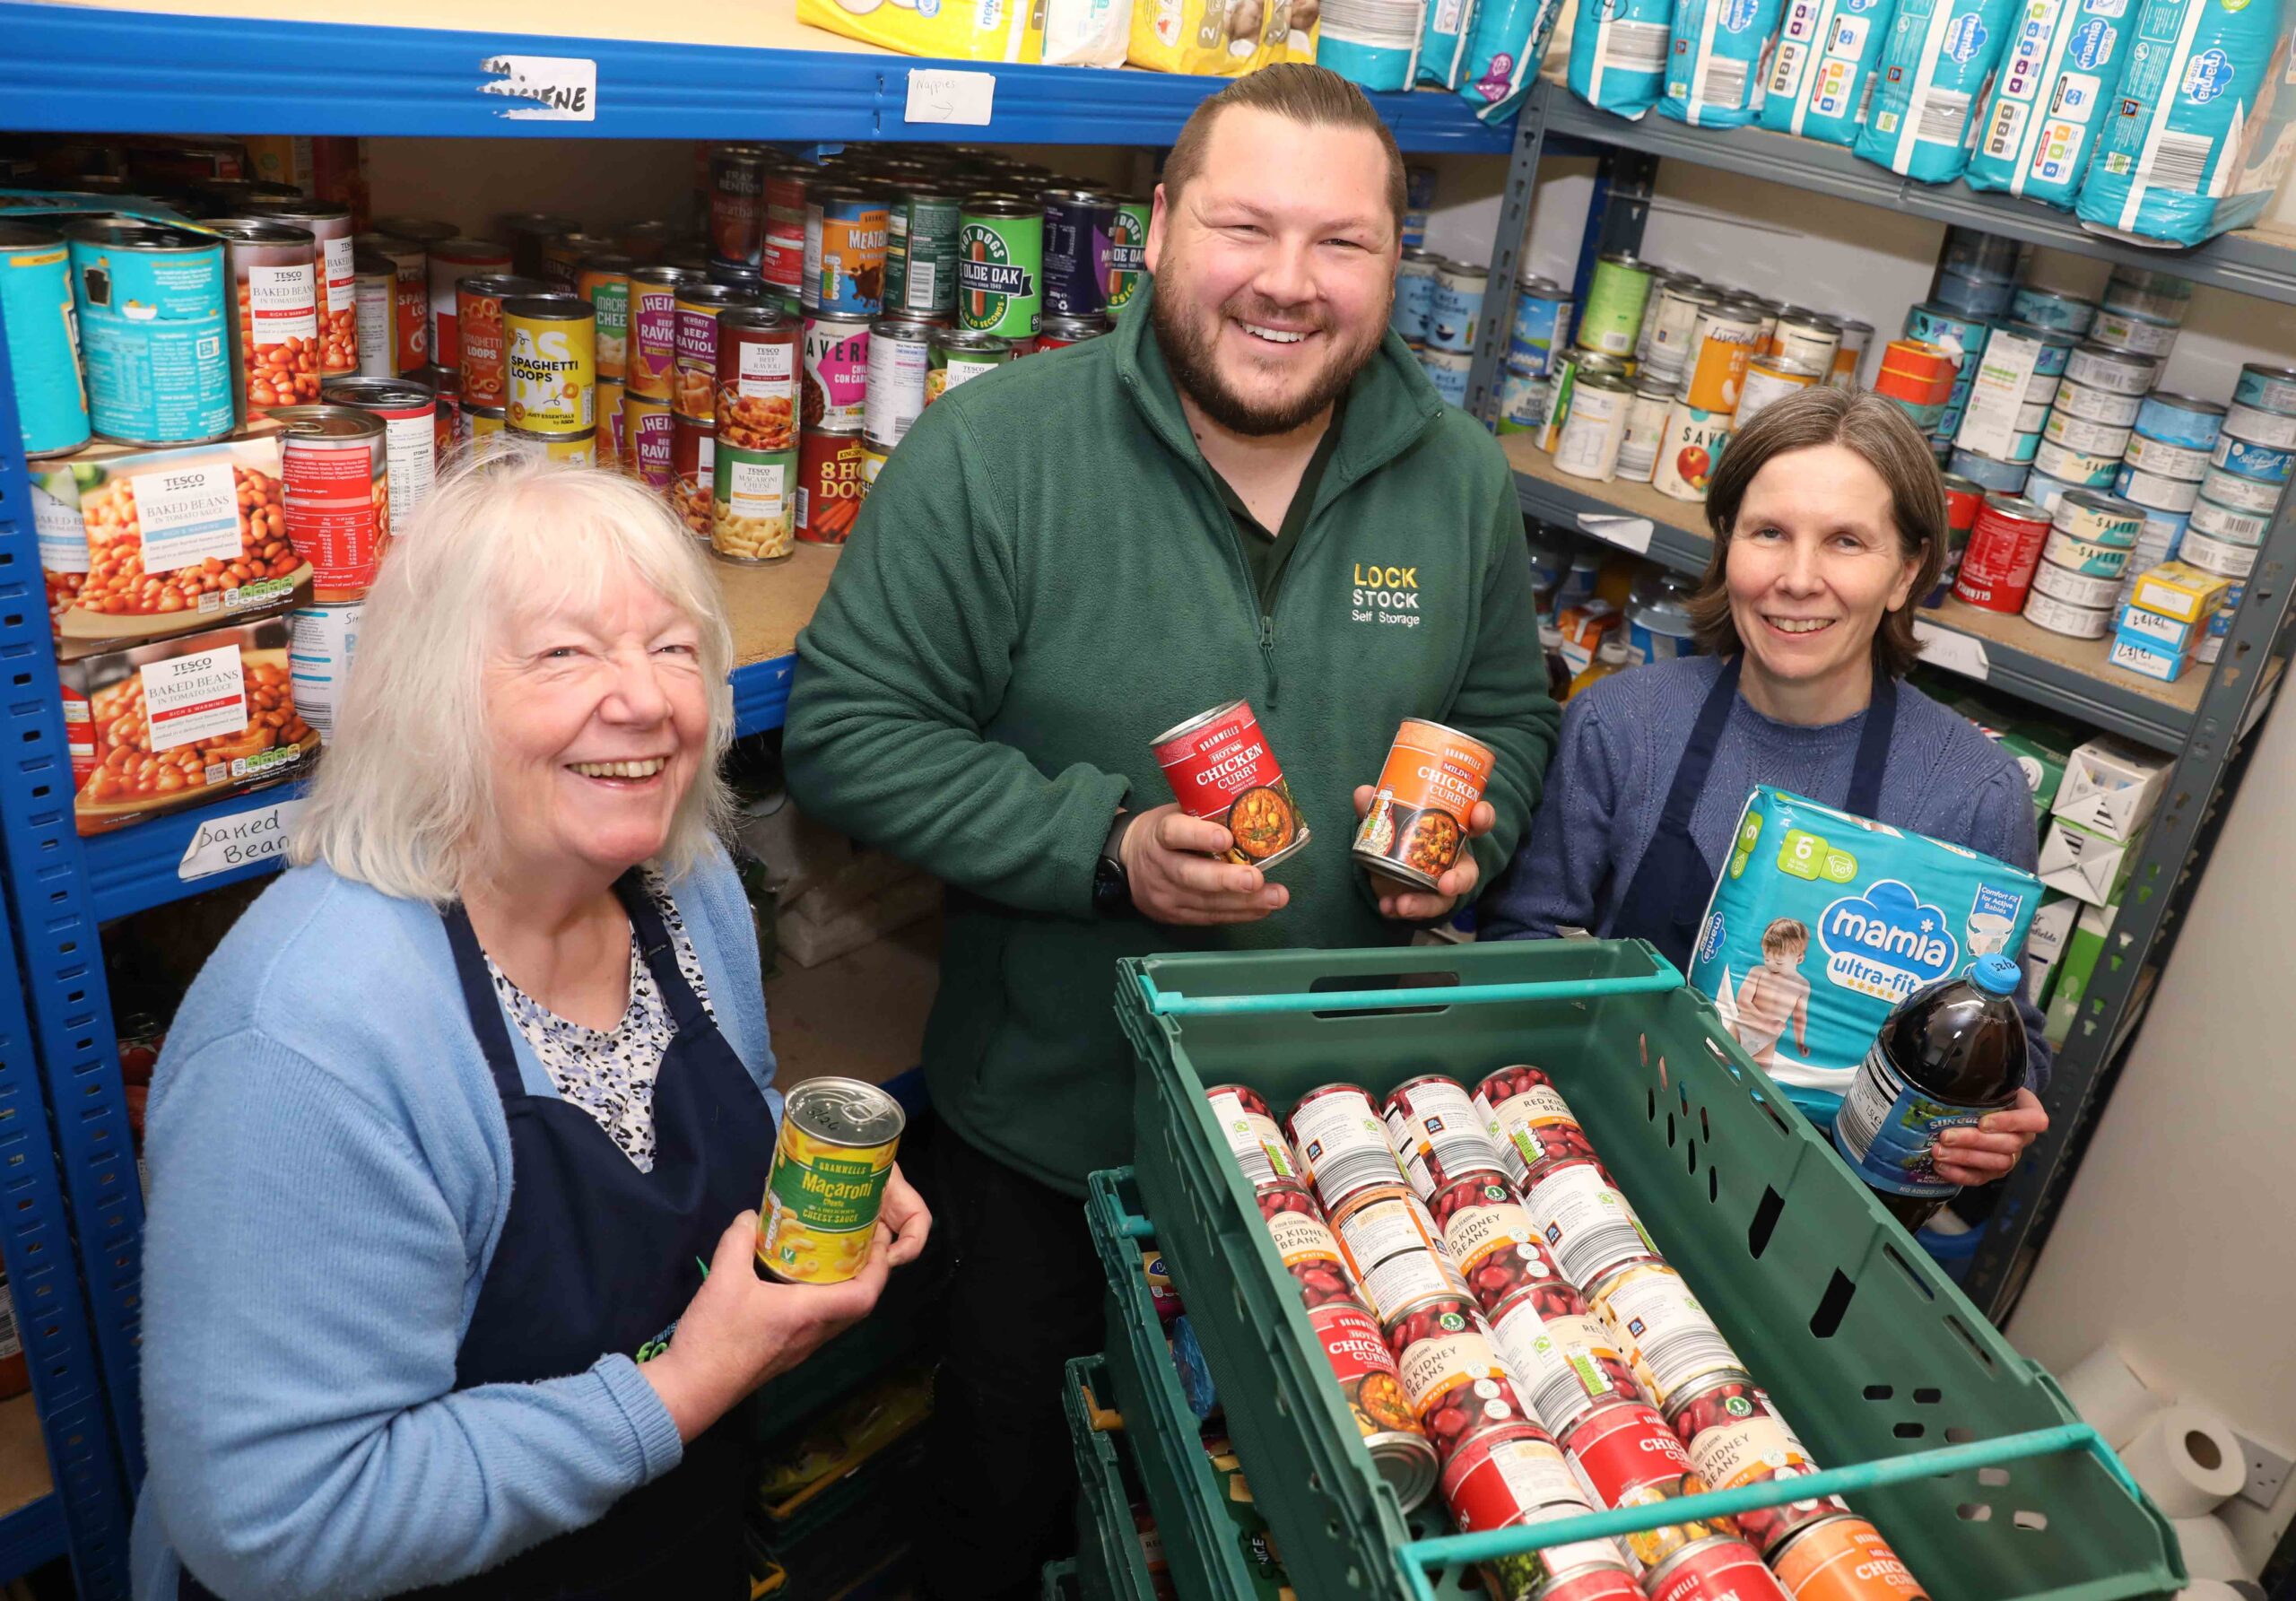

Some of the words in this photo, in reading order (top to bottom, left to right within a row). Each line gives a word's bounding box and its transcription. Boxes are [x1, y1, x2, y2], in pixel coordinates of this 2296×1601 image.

[2080, 21, 2103, 69] mamia
[916, 76, 955, 96] Nappies
[2197, 53, 2222, 100] mamia
[961, 229, 972, 253] HOT
[977, 228, 1005, 258] DOGS
[274, 271, 302, 279] TESCO
[963, 264, 988, 282] OLDE
[991, 268, 1020, 285] OAK
[253, 287, 290, 298] BAKED
[979, 300, 1005, 328] SECONDS
[683, 327, 709, 340] BEEF
[467, 345, 497, 360] LOOPS
[675, 335, 715, 353] RAVIOL
[510, 354, 578, 372] SPAGHETTI
[511, 368, 552, 383] LOOPS
[834, 373, 850, 384] CON
[641, 444, 671, 459] RAVI
[746, 466, 770, 474] TESCO
[821, 461, 836, 479] 8
[163, 473, 205, 487] TESCO
[146, 501, 187, 518] BAKED
[191, 494, 230, 509] BEANS
[167, 510, 199, 522] TOMATO
[200, 506, 223, 516] SAUCE
[1353, 562, 1419, 588] LOCK
[1352, 588, 1420, 609] STOCK
[1351, 609, 1373, 622] Self
[1378, 611, 1421, 628] Storage
[172, 657, 213, 673] TESCO
[149, 679, 194, 700] BAKED
[197, 669, 239, 689] BEANS
[158, 698, 167, 706] IN
[170, 688, 205, 702] TOMATO
[206, 683, 232, 696] SAUCE
[169, 709, 186, 718] RICH
[195, 700, 226, 712] WARMING
[1198, 725, 1240, 753] BRAMWELLS
[1195, 742, 1264, 787] CHICKEN
[1211, 747, 1232, 763] HOT
[1444, 747, 1482, 771] BRAMWELLS
[1216, 762, 1258, 790] CURRY
[1442, 761, 1465, 778] MILD
[1417, 764, 1481, 804] CHICKEN
[1428, 784, 1469, 808] CURRY
[1745, 824, 1758, 840] 6
[223, 835, 291, 864] Bean
[1795, 836, 1815, 860] 6
[1980, 893, 1992, 902] for
[1992, 898, 2014, 910] Active
[1981, 886, 2009, 901] Comfort
[2008, 894, 2019, 903] Fit
[1983, 901, 2007, 915] Babies
[1704, 917, 1723, 960] mamia
[1831, 907, 1950, 969] mamia
[1832, 954, 1918, 997] ultra-fit
[1523, 1099, 1545, 1109] RED
[1866, 1103, 1876, 1121] 1.5L
[1429, 1125, 1443, 1134] ALDI
[1929, 1118, 1956, 1130] SUN
[819, 1162, 866, 1175] BRAMWELLS
[802, 1170, 874, 1200] Macaroni
[1899, 1185, 1910, 1194] NO
[1910, 1186, 1935, 1196] ADDED
[1935, 1187, 1957, 1196] SUGAR
[802, 1207, 832, 1223] CHEESY
[833, 1213, 858, 1224] SAUCE
[1449, 1224, 1459, 1235] FOUR
[1458, 1212, 1477, 1227] SEASONS
[1286, 1228, 1329, 1240] KIDNEY
[1458, 1213, 1501, 1242] KIDNEY
[1280, 1235, 1321, 1250] BEANS
[1456, 1227, 1490, 1257] BEANS
[783, 1250, 795, 1261] V
[1300, 1251, 1326, 1261] WATER
[1465, 1260, 1473, 1270] IN
[1472, 1244, 1495, 1262] WATER
[1403, 1360, 1413, 1372] FOUR
[1412, 1345, 1431, 1362] SEASONS
[1413, 1345, 1457, 1380] KIDNEY
[1410, 1363, 1445, 1397] BEANS
[1420, 1400, 1428, 1411] IN
[1428, 1381, 1450, 1402] WATER
[1693, 1450, 1704, 1464] FOUR
[1702, 1433, 1722, 1452] SEASONS
[1704, 1431, 1750, 1470] KIDNEY
[1705, 1452, 1741, 1489] BEANS
[1727, 1471, 1750, 1489] ATER
